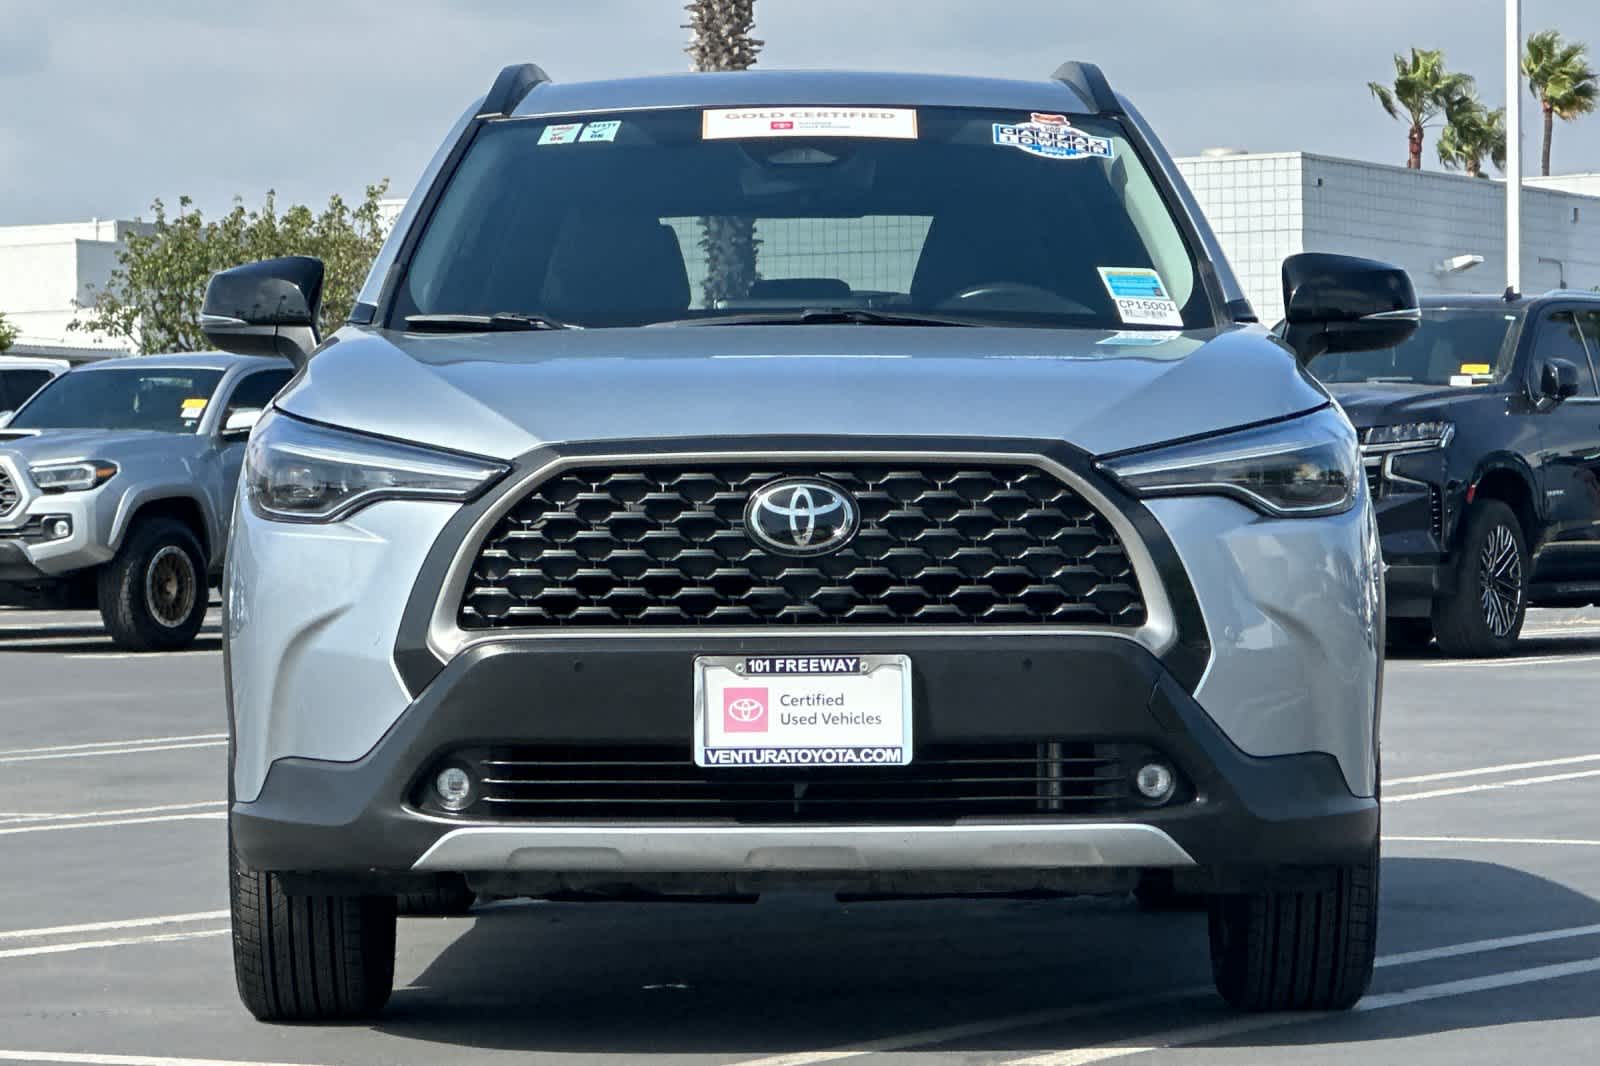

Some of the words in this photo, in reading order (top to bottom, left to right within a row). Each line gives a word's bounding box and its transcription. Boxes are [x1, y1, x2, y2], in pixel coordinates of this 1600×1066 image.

[725, 111, 784, 120] GOLD
[1003, 128, 1104, 146] CARFAX
[1119, 300, 1174, 312] CP15001
[749, 660, 770, 673] 101
[775, 659, 857, 672] FREEWAY
[780, 693, 844, 707] Certified
[780, 712, 817, 725] Used
[822, 711, 882, 725] Vehicles
[706, 748, 900, 764] VENTURATOYOTA.COM
